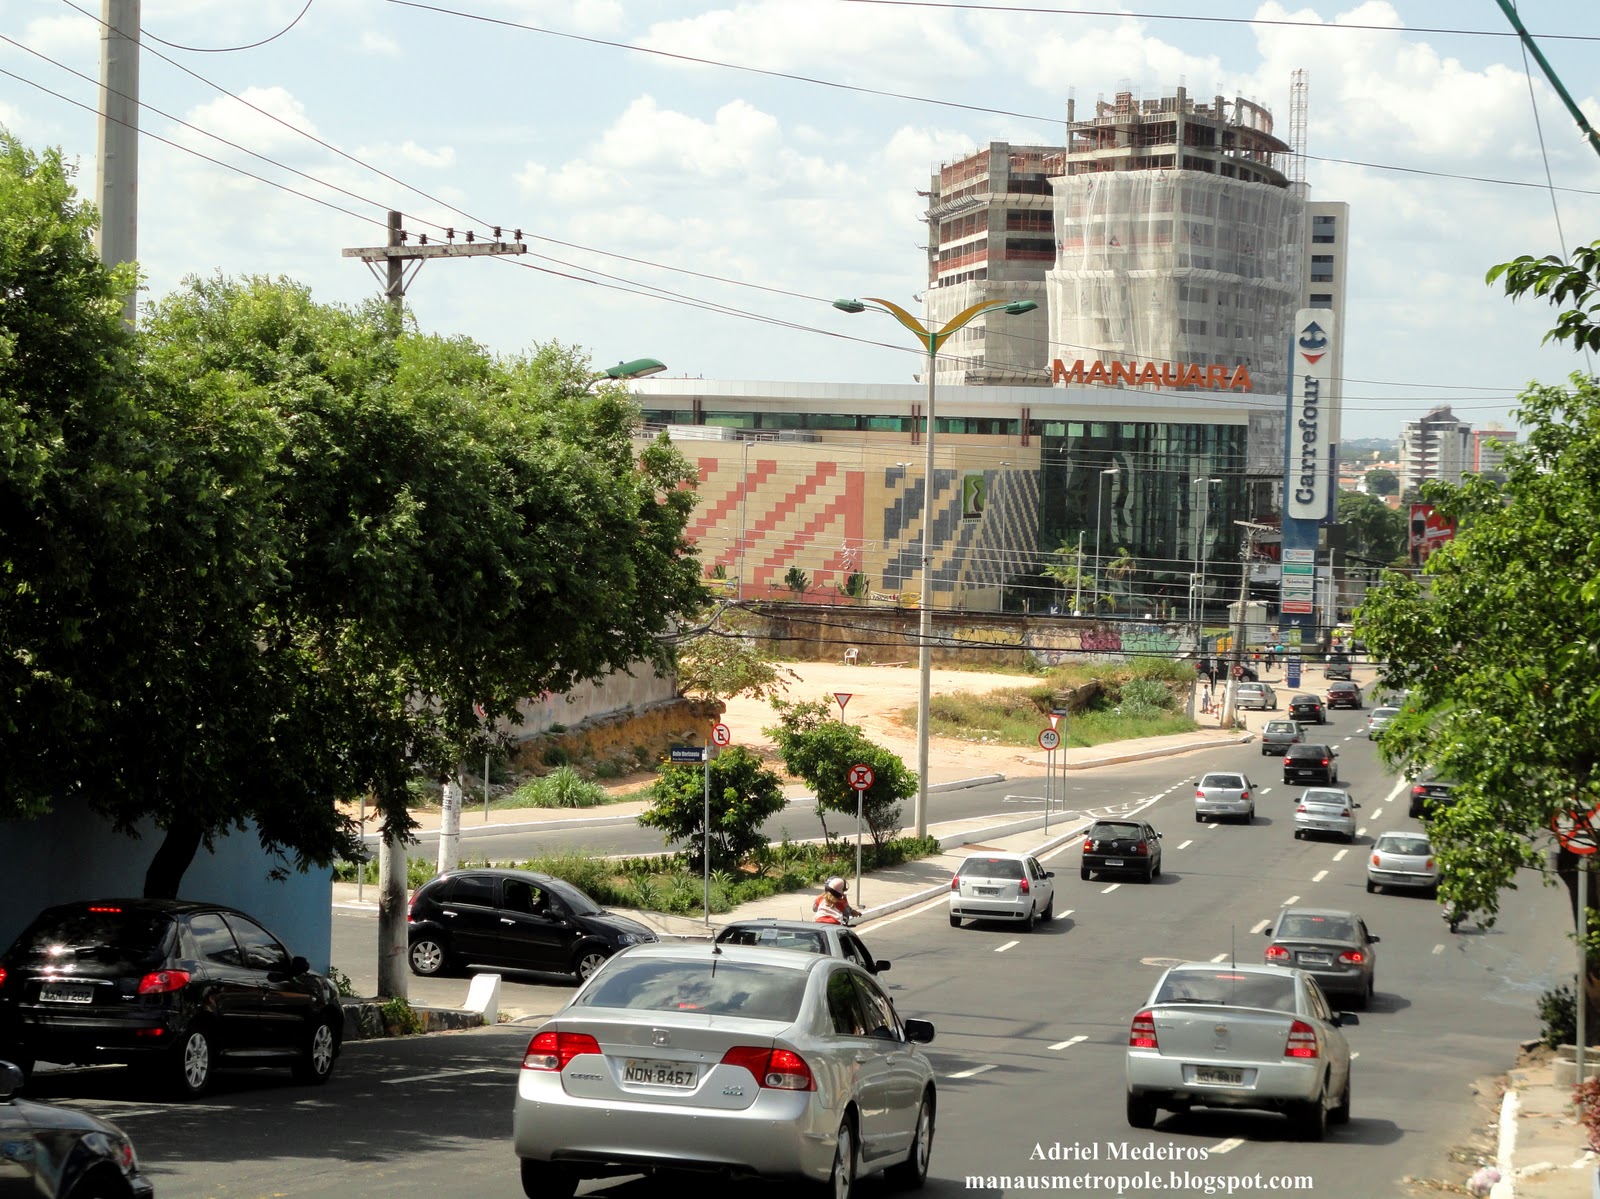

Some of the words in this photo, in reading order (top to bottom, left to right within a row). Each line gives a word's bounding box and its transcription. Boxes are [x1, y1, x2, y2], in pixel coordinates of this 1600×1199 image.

[1053, 358, 1253, 390] MANAUARA
[1295, 374, 1319, 505] Carrefour
[1043, 732, 1056, 742] 40
